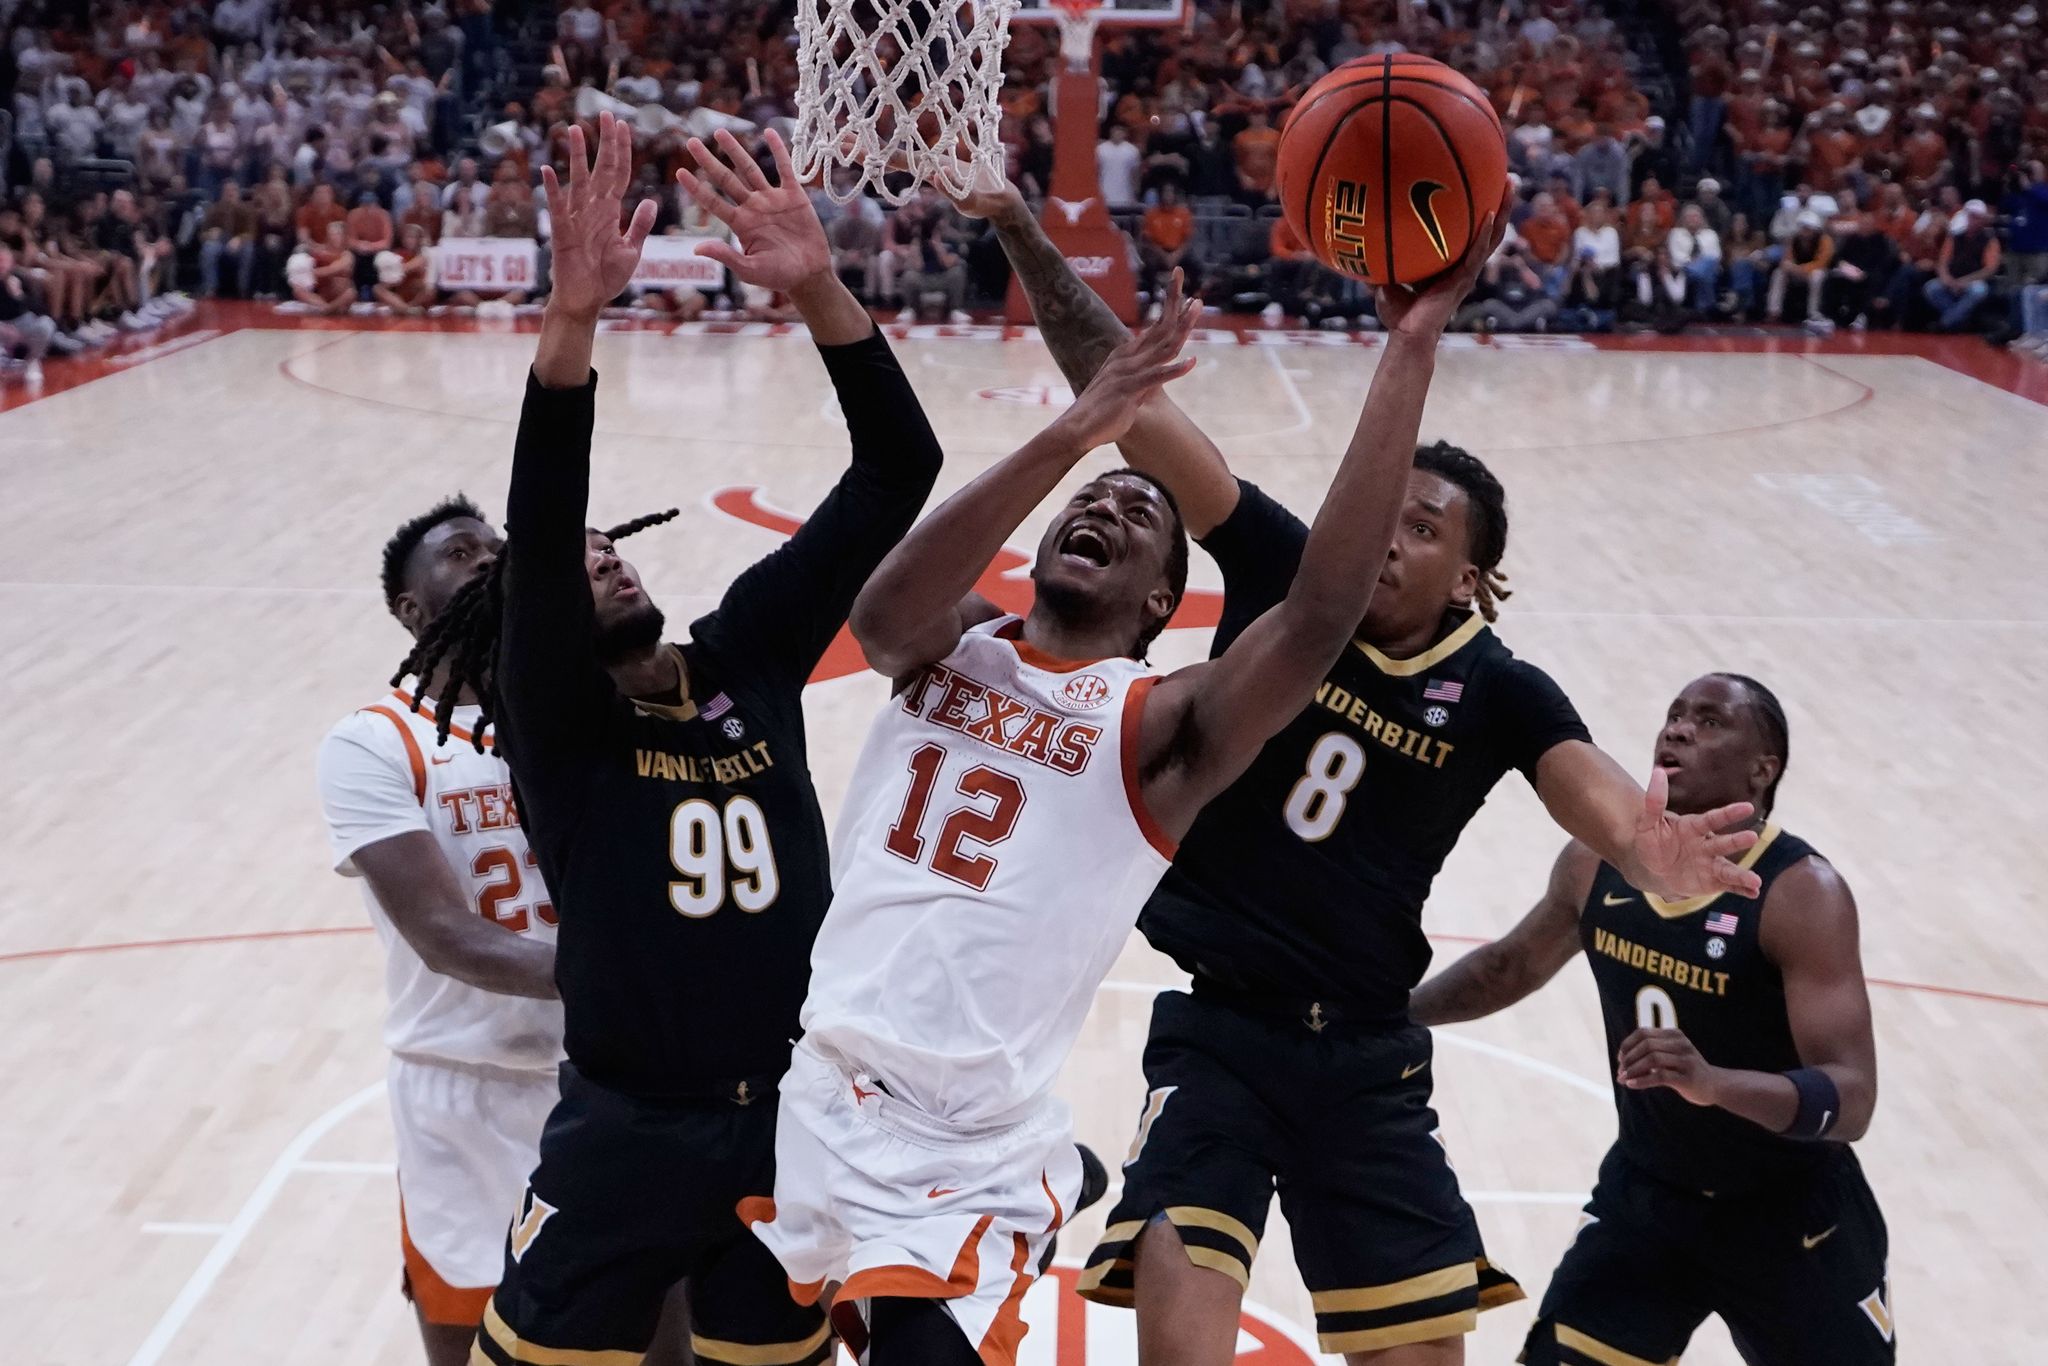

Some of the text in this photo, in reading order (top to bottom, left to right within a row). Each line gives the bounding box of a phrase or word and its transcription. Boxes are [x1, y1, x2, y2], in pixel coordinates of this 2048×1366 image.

[1333, 179, 1370, 277] ELITE
[443, 254, 528, 282] LET'S GO
[903, 662, 1103, 777] TEXAS
[1065, 675, 1107, 701] SEC
[1425, 707, 1448, 726] SEC
[723, 718, 744, 738] SEC
[1314, 681, 1455, 768] NDERBILT
[636, 740, 774, 785] VANBILT
[1283, 731, 1366, 842] 8
[437, 783, 521, 835] TEX
[884, 742, 1027, 892] 12
[668, 794, 780, 919] 99
[1594, 927, 1730, 996] VANDERBILT
